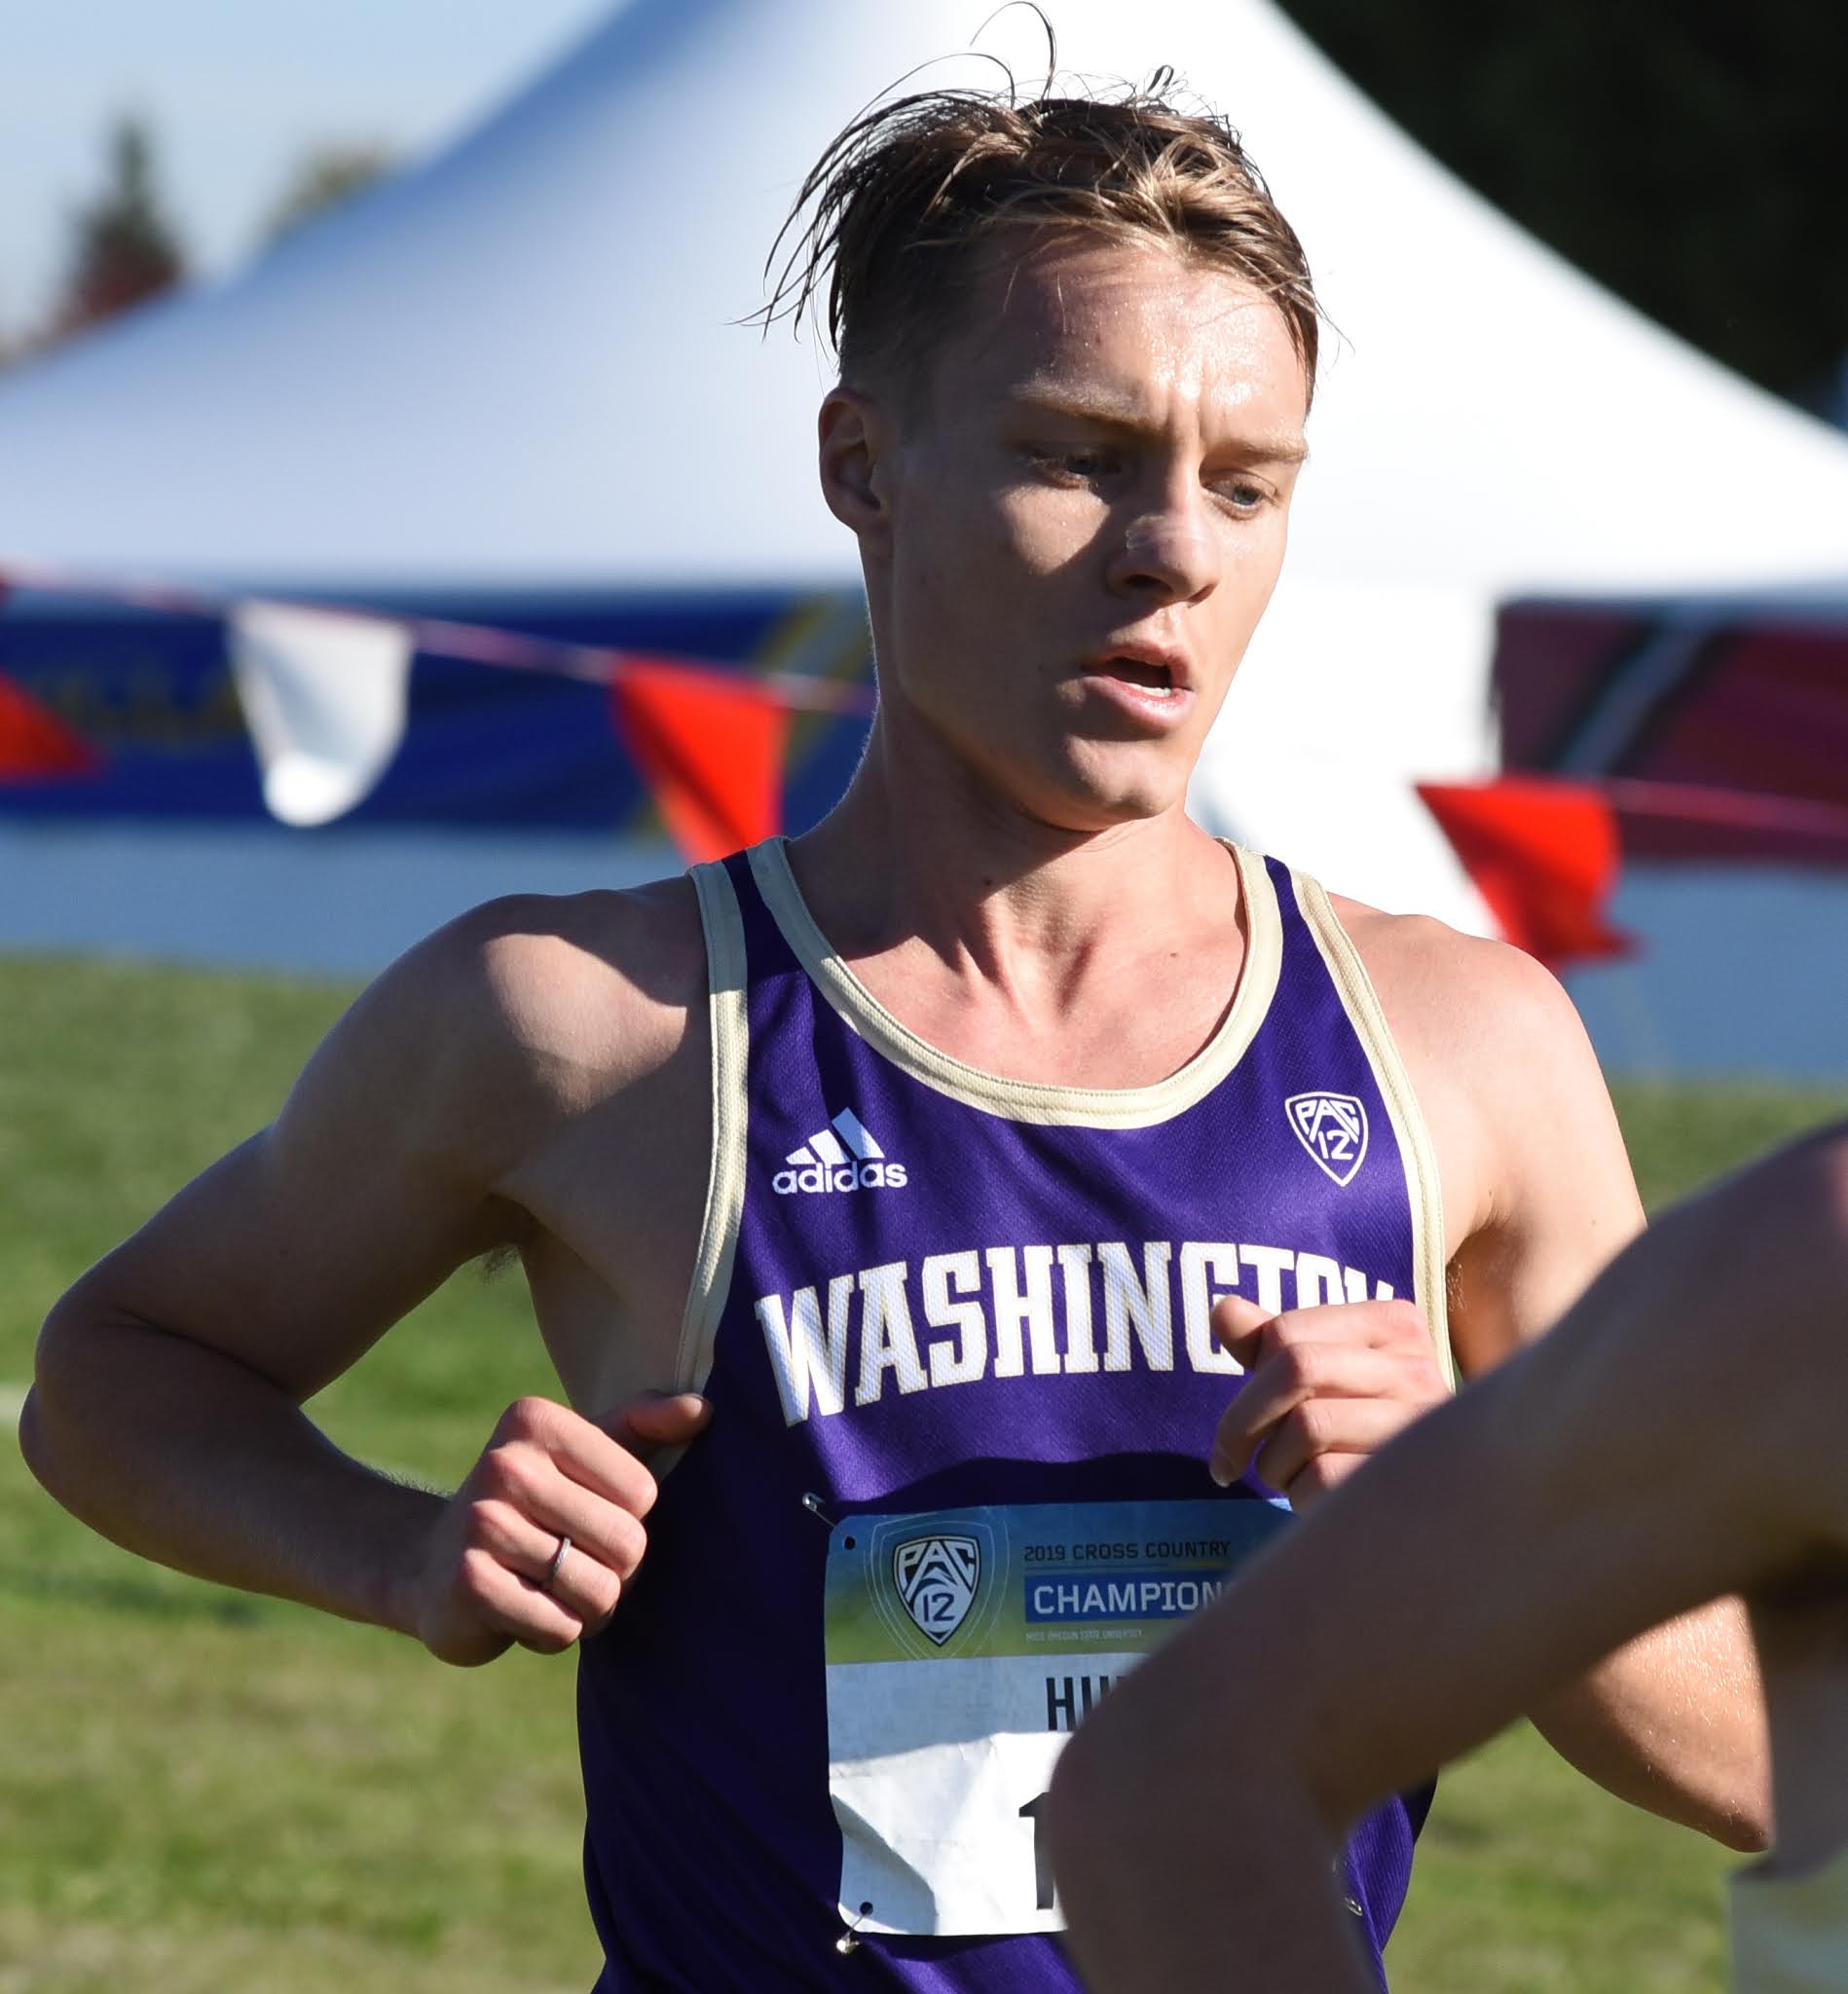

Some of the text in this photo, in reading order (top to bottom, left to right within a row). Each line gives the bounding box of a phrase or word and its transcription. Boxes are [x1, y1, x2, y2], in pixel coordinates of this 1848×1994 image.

[1295, 1099, 1360, 1144] PAC
[1317, 1129, 1354, 1160] 12
[772, 1162, 907, 1195] adidas
[755, 1240, 1394, 1428] WASHINGT
[1023, 1541, 1231, 1562] 2019 CROSS COUNTRY
[899, 1540, 975, 1605] PAC
[923, 1592, 955, 1622] 12
[1033, 1581, 1231, 1614] CHAMPION
